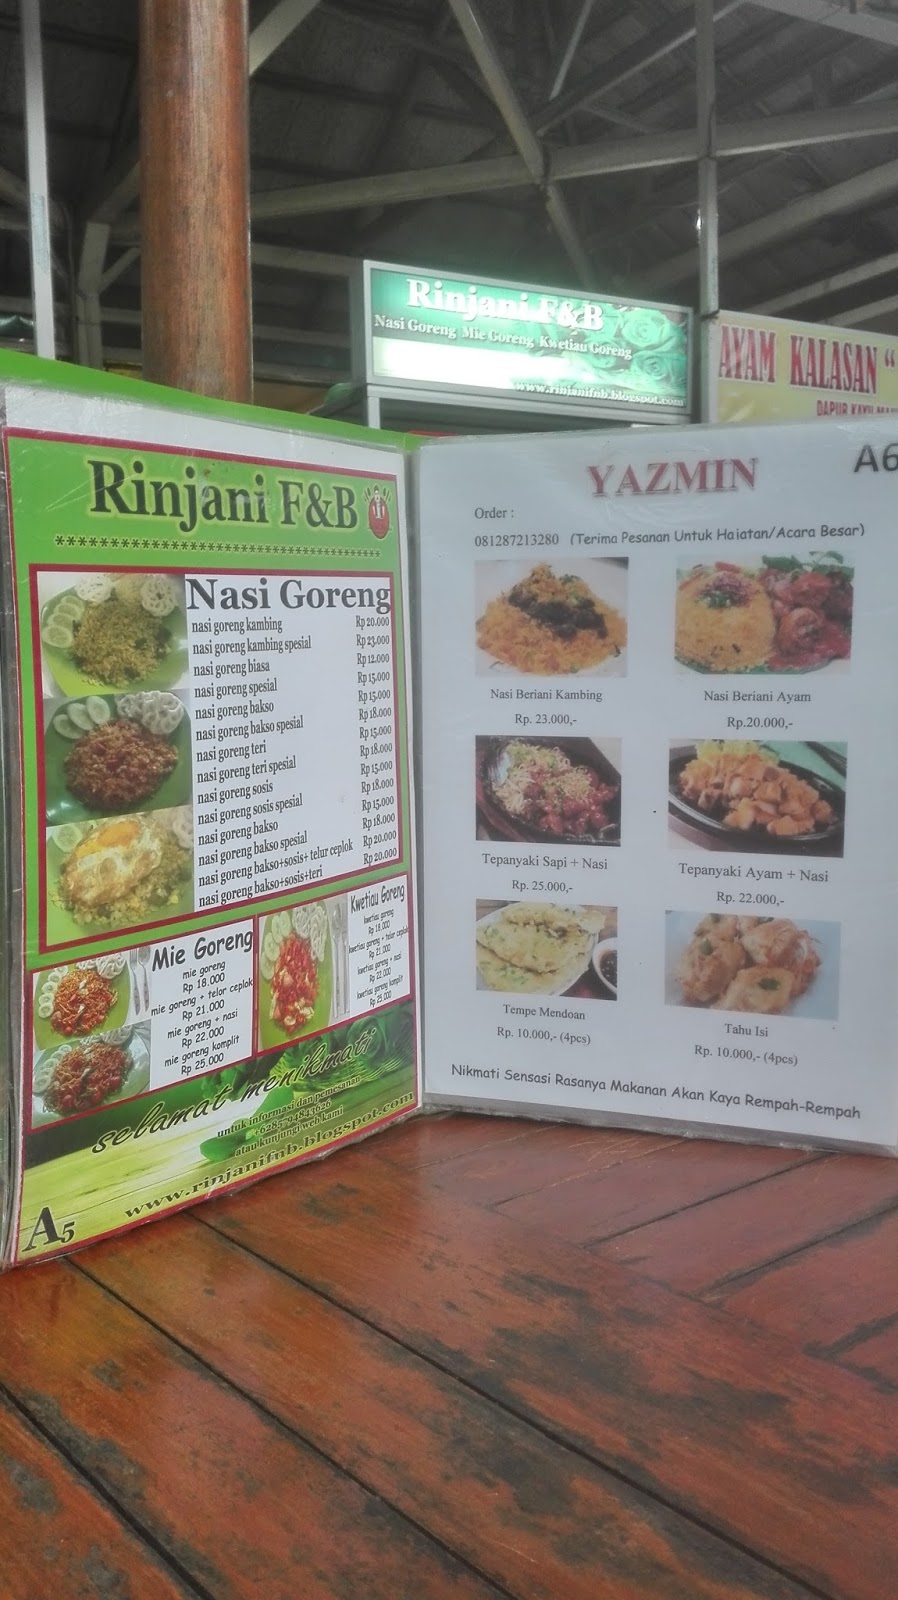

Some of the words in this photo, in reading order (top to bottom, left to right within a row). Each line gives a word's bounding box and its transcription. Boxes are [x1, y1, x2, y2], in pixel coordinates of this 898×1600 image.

[406, 278, 529, 322] Rinjani
[534, 296, 604, 331] F&B
[373, 314, 405, 330] Nasi
[408, 319, 456, 340] Goreng
[462, 326, 486, 341] Mie
[488, 330, 535, 348] Goreng
[539, 336, 587, 353] Kwetiau
[590, 342, 633, 360] Goreng
[719, 325, 776, 383] AYAM
[790, 335, 877, 394] KALASAN
[853, 443, 898, 474] A6
[587, 458, 759, 498] YAZMIN
[87, 458, 269, 533] Rinjani
[279, 479, 358, 529] F&B
[474, 506, 508, 520] Order
[474, 533, 559, 548] 081287213280
[570, 530, 618, 546] (Terima
[621, 529, 669, 544] Pesanan
[674, 528, 713, 542] Untuk
[820, 523, 865, 539] Besar)
[186, 577, 270, 610] Nasi
[280, 580, 391, 614] Goreng
[192, 620, 211, 633] nasi
[214, 620, 245, 635] goreng
[247, 617, 282, 633] kambing
[367, 617, 389, 627] 20.000
[193, 642, 212, 655] nasi
[215, 641, 245, 657] goreng
[247, 638, 283, 653] kambing
[285, 636, 311, 650] spesial
[367, 636, 389, 647] 23.000
[194, 663, 213, 676] nasi
[216, 662, 247, 678] goreng
[248, 659, 270, 673] biasa
[368, 654, 389, 664] 12.000
[194, 685, 214, 698] nasi
[216, 684, 247, 700] goreng
[249, 679, 277, 696] spesial
[368, 673, 390, 683] 15.000
[490, 688, 513, 701] Nasi
[516, 688, 553, 701] Beriani
[555, 688, 603, 704] Kambing
[704, 689, 729, 703] Nasi
[732, 689, 773, 703] Beriani
[776, 689, 811, 704] Ayam
[196, 727, 215, 741] nasi
[218, 725, 249, 742] goreng
[251, 722, 274, 735] bakso
[276, 715, 303, 733] spesial
[369, 708, 392, 718] 18.000
[514, 713, 532, 727] Rp.
[535, 713, 578, 726] 23.000,-
[726, 715, 793, 729] Rp.20.000,-
[197, 747, 216, 762] nasi
[218, 745, 250, 763] goreng
[251, 740, 266, 754] teri
[370, 726, 392, 737] 15.000
[197, 768, 216, 783] nasi
[219, 766, 250, 783] goreng
[252, 761, 267, 774] teri
[269, 756, 296, 774] spesial
[371, 744, 392, 755] 18.000
[197, 788, 217, 804] nasi
[219, 786, 251, 804] goreng
[253, 780, 273, 794] sosis
[371, 762, 393, 773] 15.000
[198, 809, 217, 824] nasi
[220, 807, 252, 824] goreng
[253, 801, 274, 815] sosis
[275, 793, 303, 812] spesial
[372, 779, 394, 790] 18.000
[198, 850, 218, 866] nasi
[221, 846, 252, 865] goreng
[254, 838, 279, 854] bakso
[281, 832, 308, 851] spesial
[373, 814, 395, 825] 18.000
[199, 870, 218, 886] nasi
[221, 866, 253, 885] goreng
[310, 847, 329, 861] telur
[330, 839, 353, 858] ceplok
[374, 832, 397, 843] 20.000
[482, 853, 539, 869] Tepanyaki
[542, 855, 569, 870] Sapi
[582, 856, 608, 870] Nasi
[678, 862, 742, 879] Tepanyaki
[745, 865, 783, 882] Ayam
[800, 868, 829, 882] Nasi
[199, 890, 219, 907] nasi
[221, 884, 253, 905] goreng
[254, 866, 323, 894] bakso+sosis+teri
[374, 847, 397, 859] 20.000
[511, 879, 529, 892] Rp.
[532, 881, 573, 893] 25.000,-
[350, 892, 378, 913] Kwetiau
[382, 885, 405, 903] Goreng
[716, 890, 736, 905] Rp.
[739, 891, 785, 906] 22.000,-
[152, 946, 185, 972] Mie
[194, 931, 253, 960] Goreng
[183, 968, 196, 979] mie
[200, 961, 226, 977] goreng
[197, 973, 225, 988] 18.000
[151, 1004, 165, 1016] mie
[169, 997, 196, 1014] goreng
[208, 987, 227, 999] telor
[230, 978, 253, 993] ceplok
[196, 999, 224, 1016] 21.000
[503, 1003, 536, 1018] Tempe
[538, 1006, 585, 1021] Mendoan
[167, 1027, 181, 1039] mie
[185, 1019, 211, 1036] goreng
[223, 1009, 238, 1021] nasi
[196, 1026, 224, 1043] 22.000
[497, 1026, 513, 1040] Rp.
[516, 1027, 557, 1042] 10.000,-
[559, 1031, 591, 1046] (4pcs)
[724, 1022, 752, 1036] Tahu
[754, 1024, 768, 1037] Isi
[164, 1055, 179, 1067] mie
[182, 1047, 209, 1063] goreng
[212, 1035, 239, 1051] komplit
[195, 1053, 224, 1070] 25.000
[694, 1044, 713, 1059] Rp.
[716, 1046, 760, 1062] 10.000,-
[763, 1050, 798, 1067] (4pcs)
[91, 1091, 232, 1155] selamat
[240, 1027, 377, 1104] menikmati
[451, 1063, 500, 1081] Nikmati
[504, 1067, 551, 1085] Sensasi
[554, 1071, 607, 1093] Rasanya
[610, 1079, 666, 1097] Makanan
[671, 1085, 705, 1101] Akan
[709, 1088, 741, 1106] Kaya
[745, 1092, 861, 1120] Rempah-Rempah
[218, 1123, 247, 1138] untuk
[249, 1102, 295, 1128] informasi
[297, 1096, 313, 1108] dan
[315, 1076, 361, 1103] pemesanan
[235, 1143, 257, 1157] atau
[259, 1124, 301, 1148] kunjungi
[303, 1118, 320, 1130] web
[322, 1106, 344, 1122] kami
[124, 1091, 414, 1219] www.rinjanifnb.blogspot.com
[22, 1207, 76, 1253] A5
